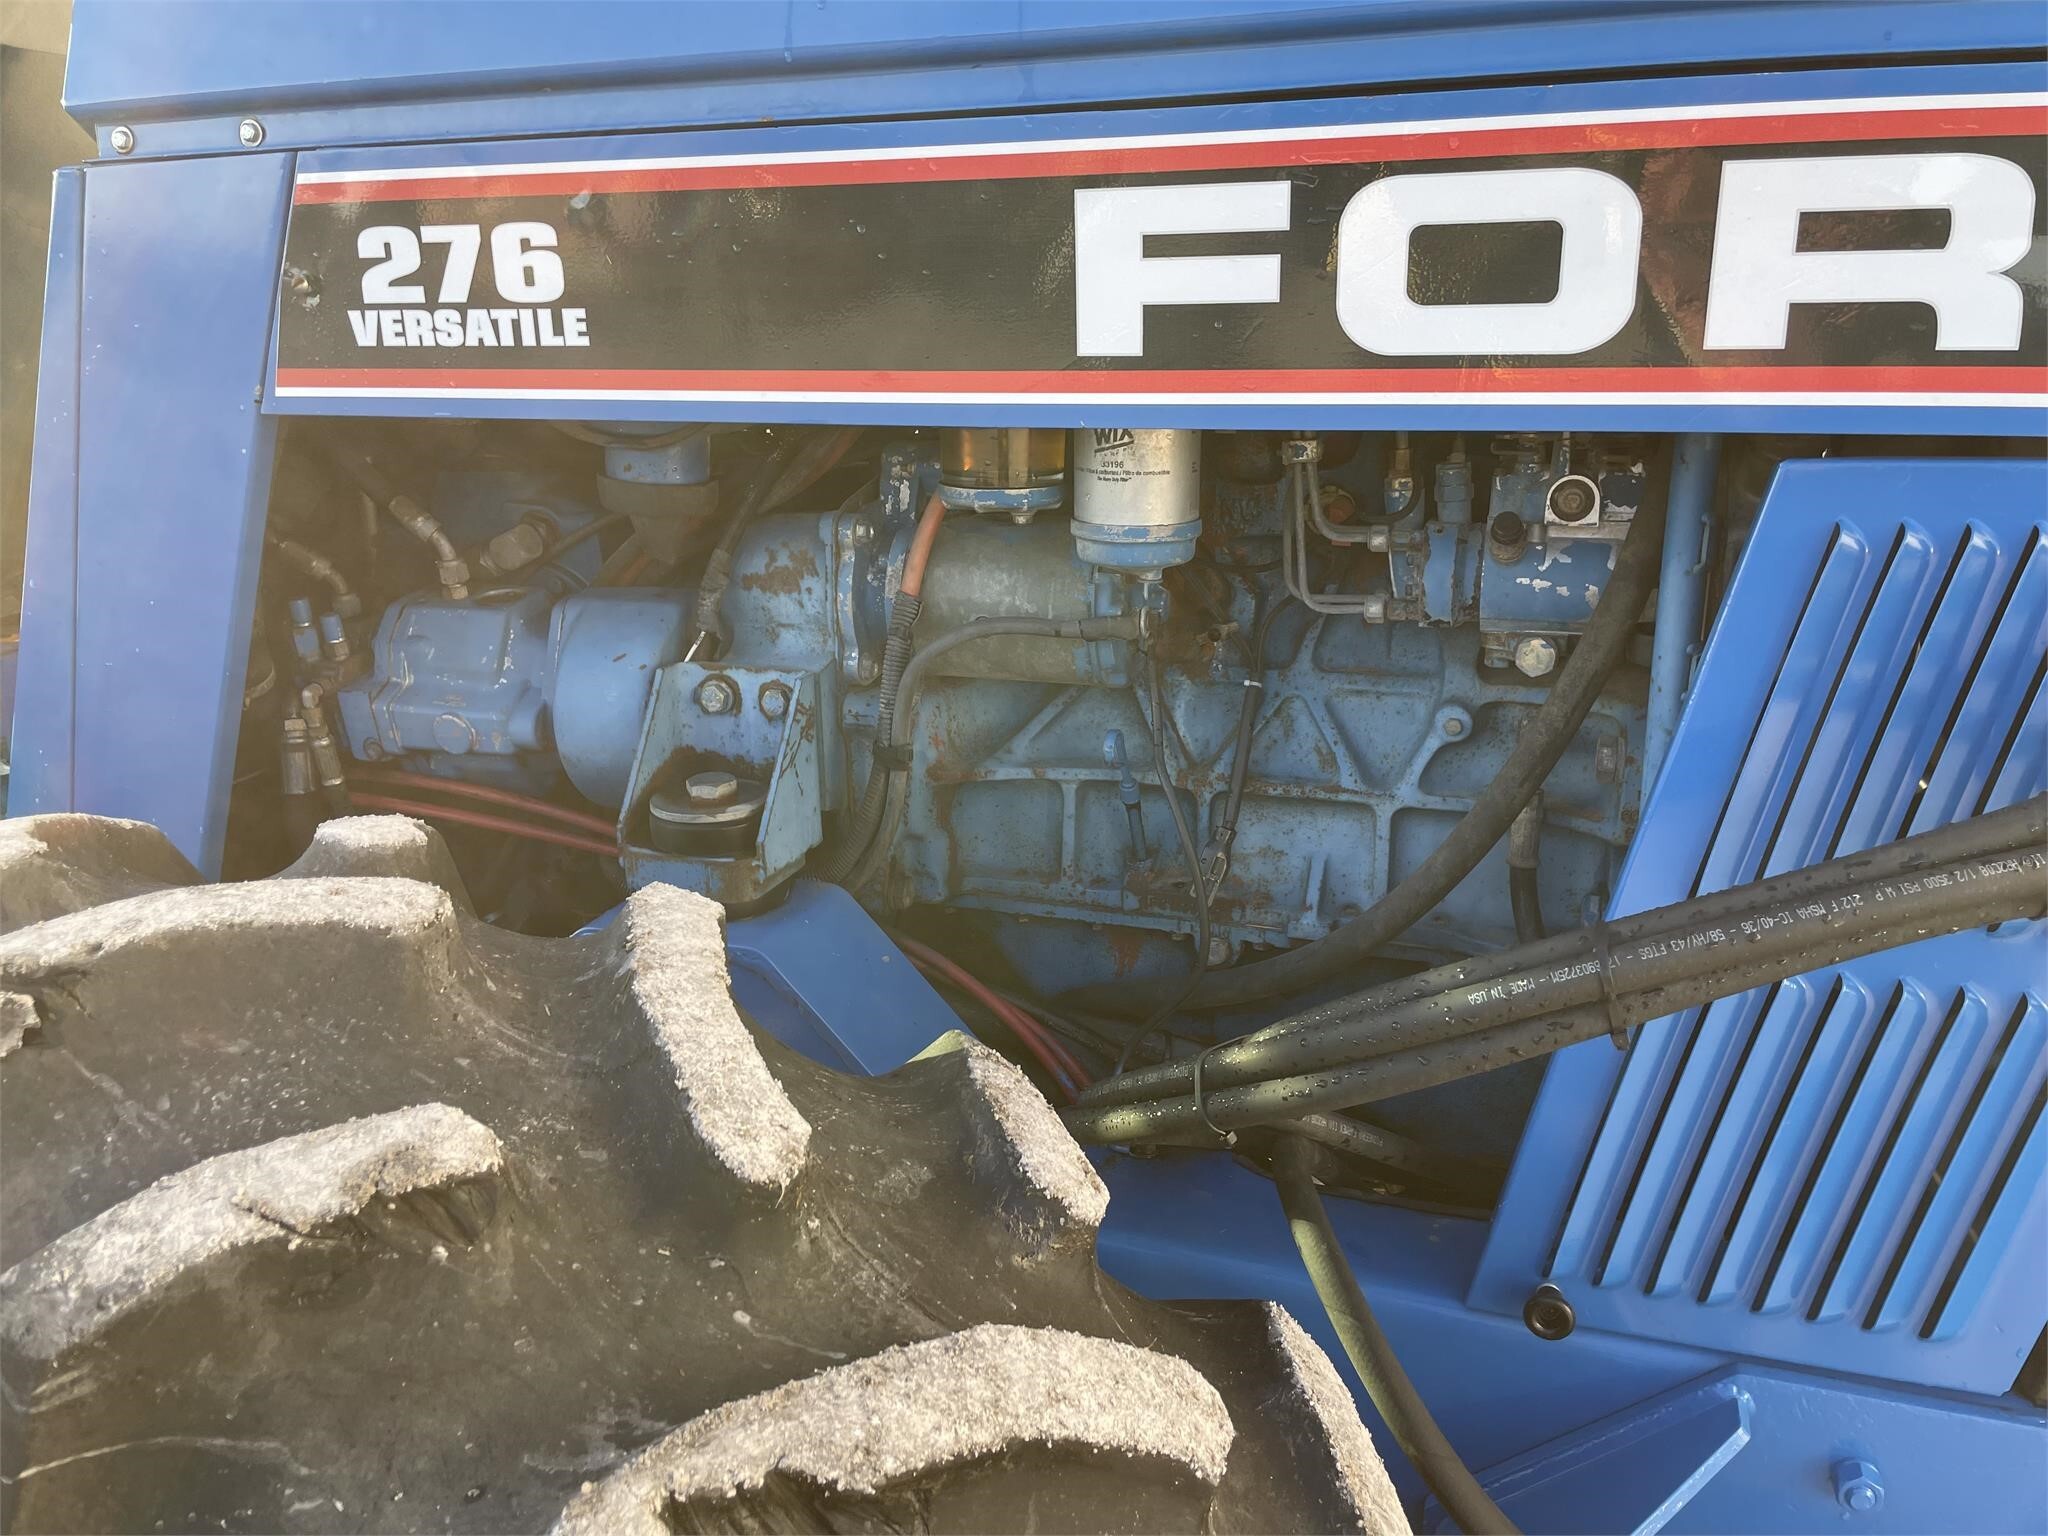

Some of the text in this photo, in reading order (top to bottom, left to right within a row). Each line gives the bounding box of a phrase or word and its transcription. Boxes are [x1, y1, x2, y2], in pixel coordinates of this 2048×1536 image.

[357, 222, 565, 304] 276
[1074, 153, 2037, 358] FOR
[347, 308, 591, 348] VERSATILE
[1923, 874, 1953, 889] 3500
[1953, 868, 1976, 882] 1/2
[1898, 881, 1922, 895] PSI
[1795, 902, 1827, 920] MSHA
[1741, 911, 1794, 934] IC-40/36
[1638, 943, 1667, 960] FTGS
[1490, 985, 1506, 999] IN
[1508, 977, 1536, 994] MADE
[1467, 990, 1488, 1005] USA
